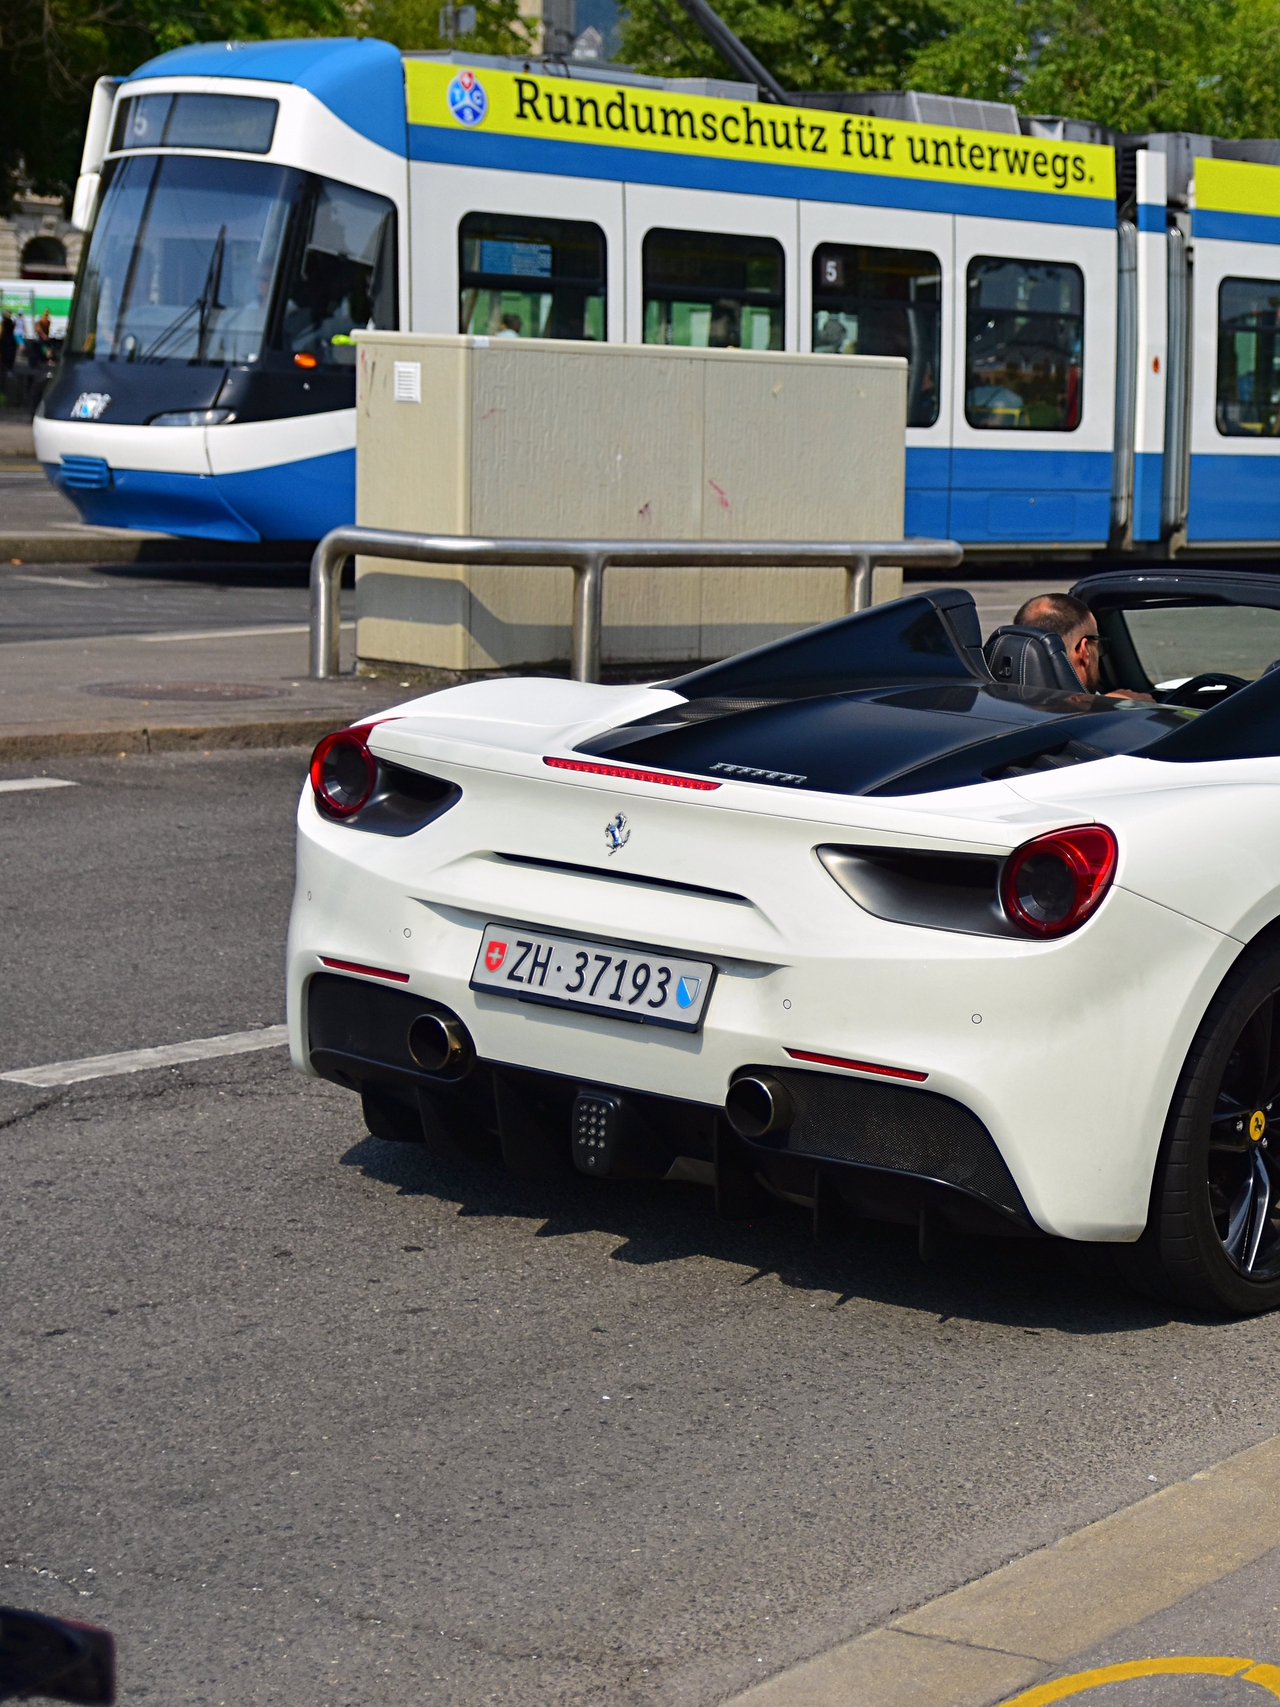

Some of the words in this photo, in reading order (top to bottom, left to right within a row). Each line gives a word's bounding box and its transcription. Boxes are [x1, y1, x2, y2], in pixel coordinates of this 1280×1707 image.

[514, 78, 827, 153] Rundumschutz
[841, 118, 895, 160] für
[908, 134, 1095, 189] unterwegs.
[825, 260, 838, 283] 5
[709, 762, 808, 785] FERRARI
